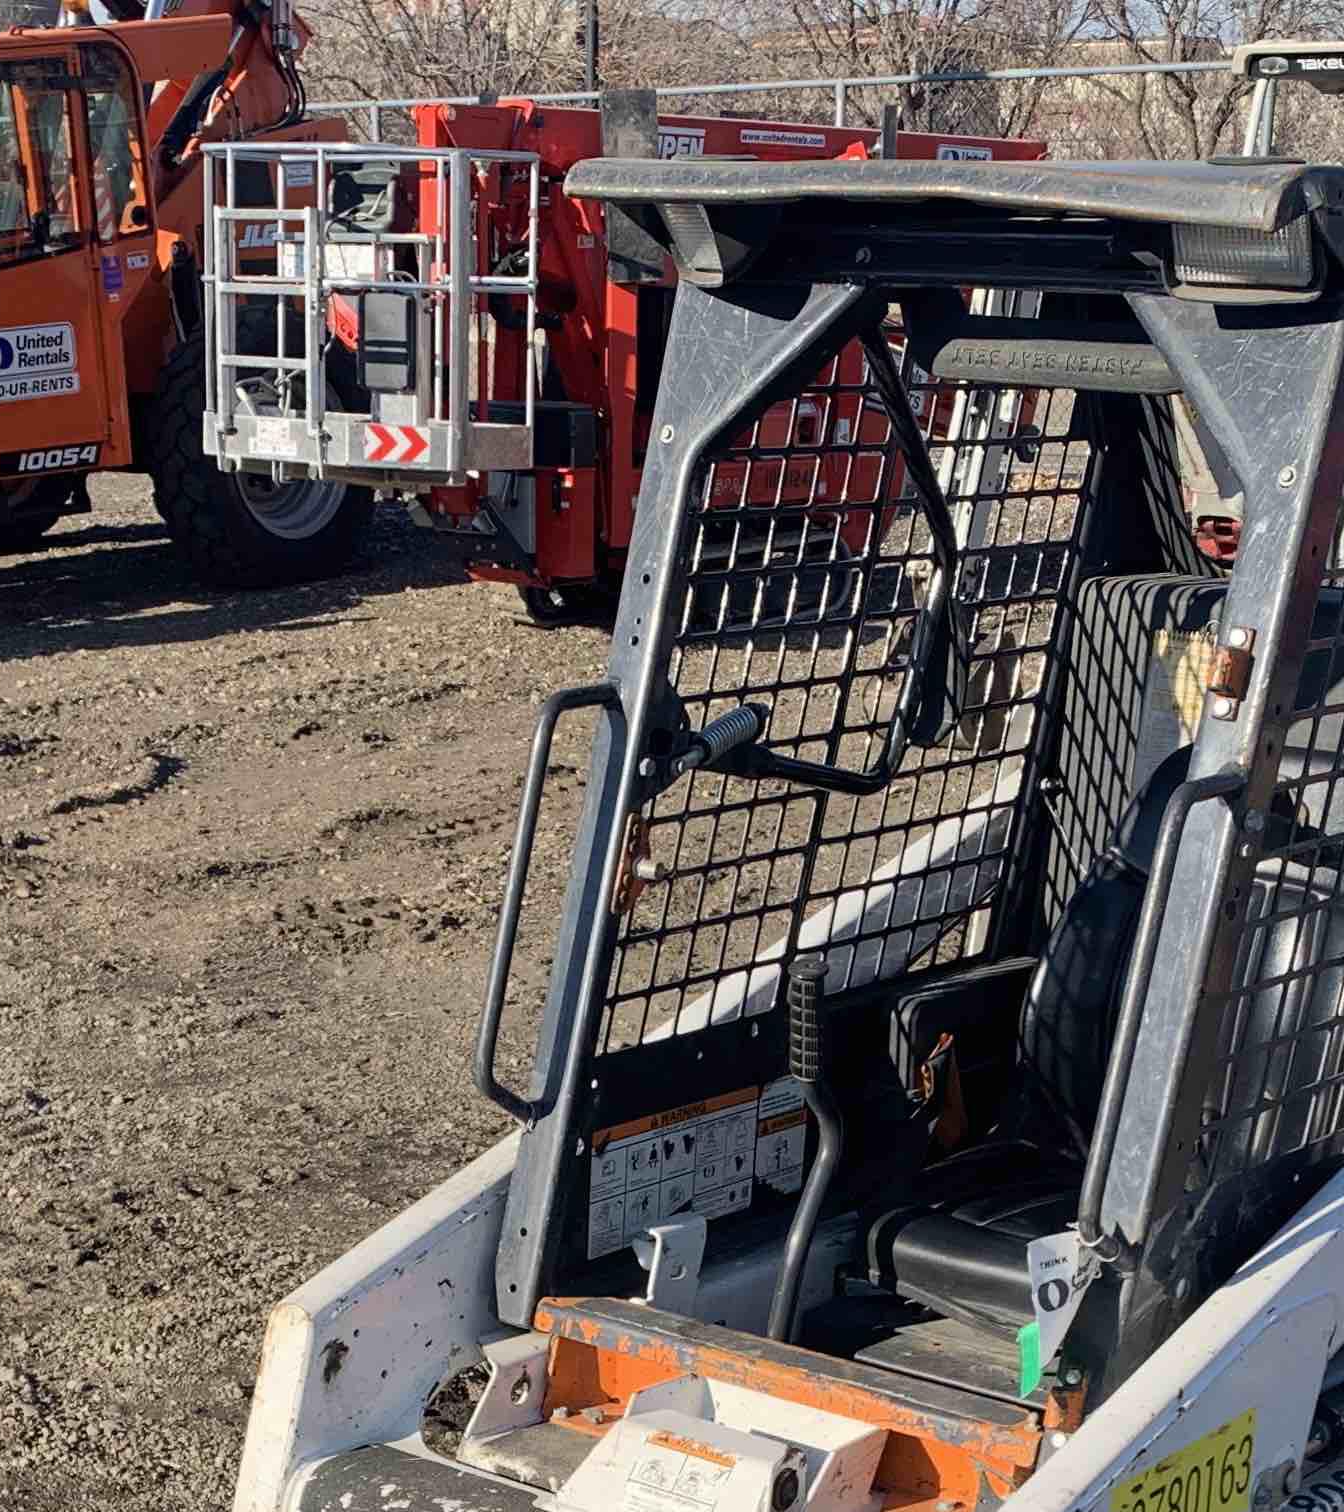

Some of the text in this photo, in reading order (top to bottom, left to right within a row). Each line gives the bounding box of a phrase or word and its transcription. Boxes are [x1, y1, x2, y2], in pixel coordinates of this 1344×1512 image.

[16, 331, 64, 350] United
[18, 349, 71, 369] Rentals
[17, 445, 98, 472] 10054
[1039, 1255, 1069, 1271] THINK
